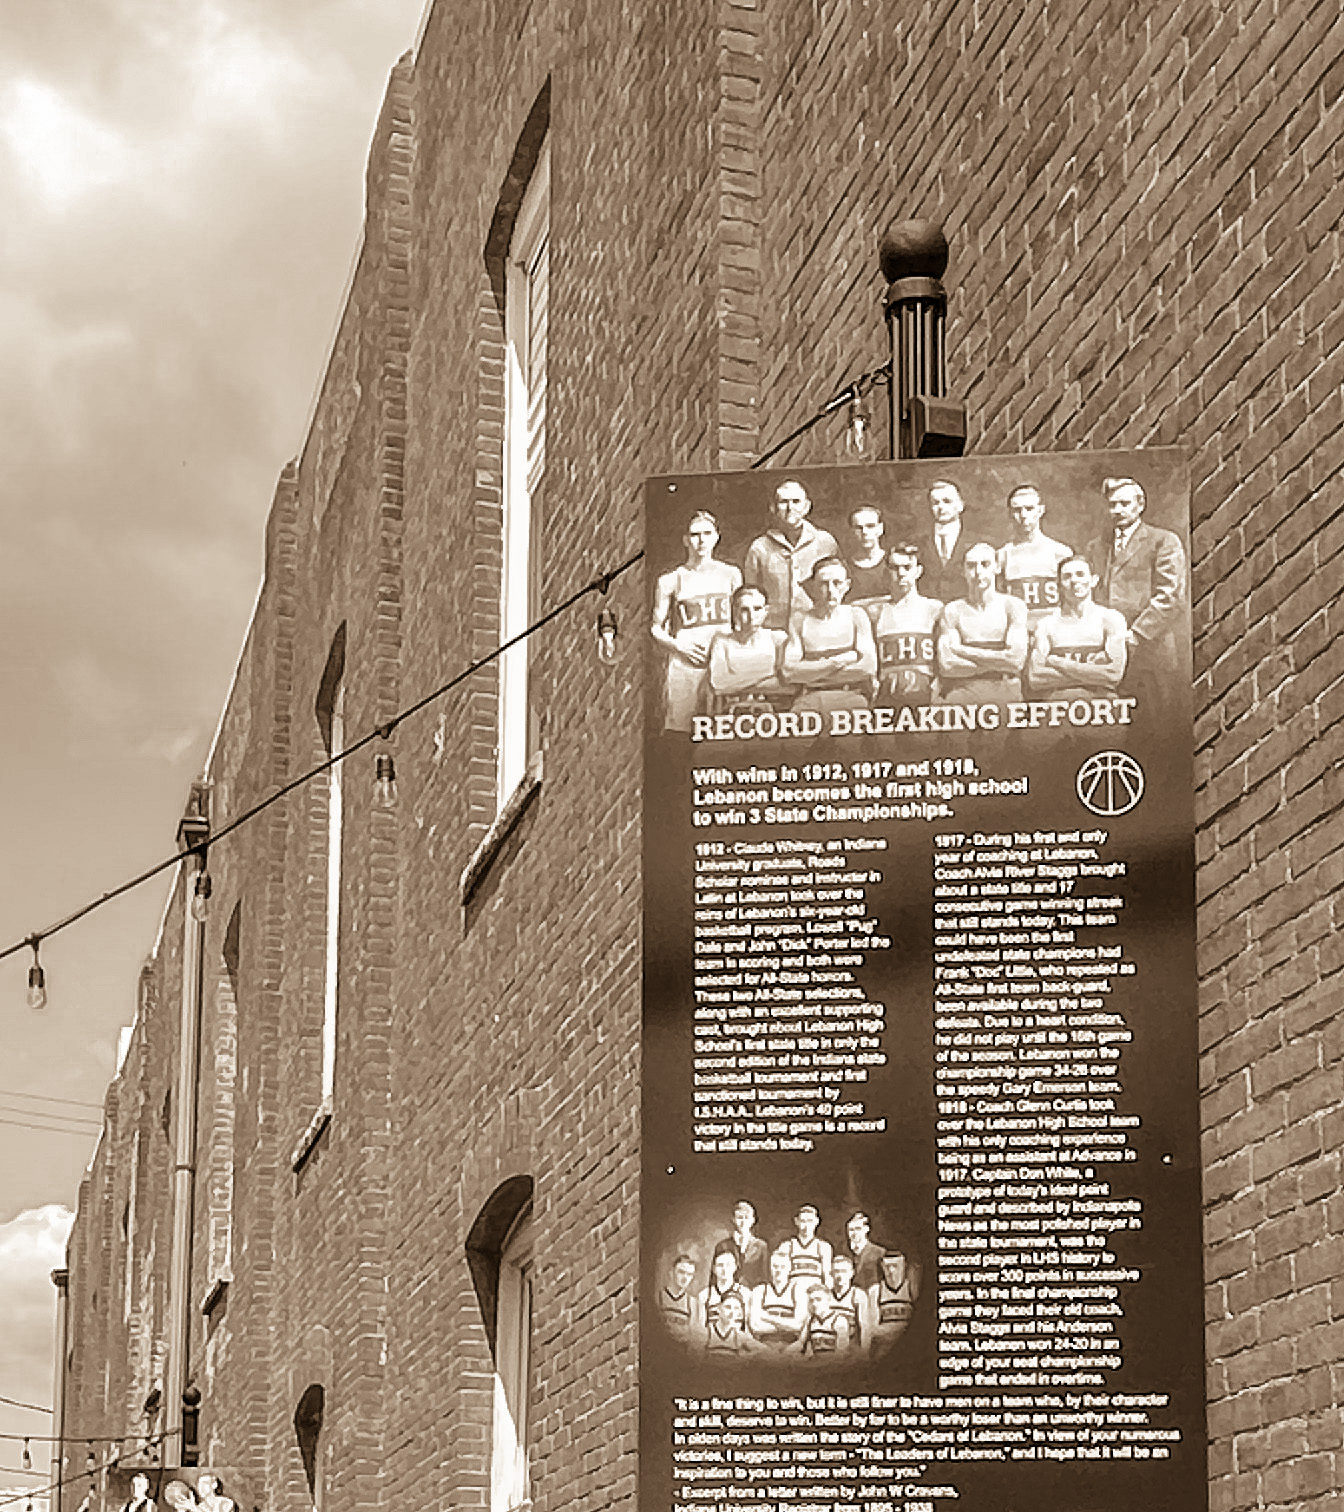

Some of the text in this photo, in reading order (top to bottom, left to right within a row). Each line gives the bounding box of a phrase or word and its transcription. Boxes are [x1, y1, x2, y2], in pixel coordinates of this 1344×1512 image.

[692, 697, 1137, 742] RECORD BREAKING EFFORT
[693, 769, 732, 785] With
[736, 767, 777, 784] wins
[781, 766, 797, 781] in
[803, 764, 847, 782] 1912,
[852, 762, 892, 779] 1917
[895, 760, 929, 777] and
[693, 777, 1028, 805] Lebanon becomes the first high school
[693, 802, 954, 826] to win 3 State Championships.
